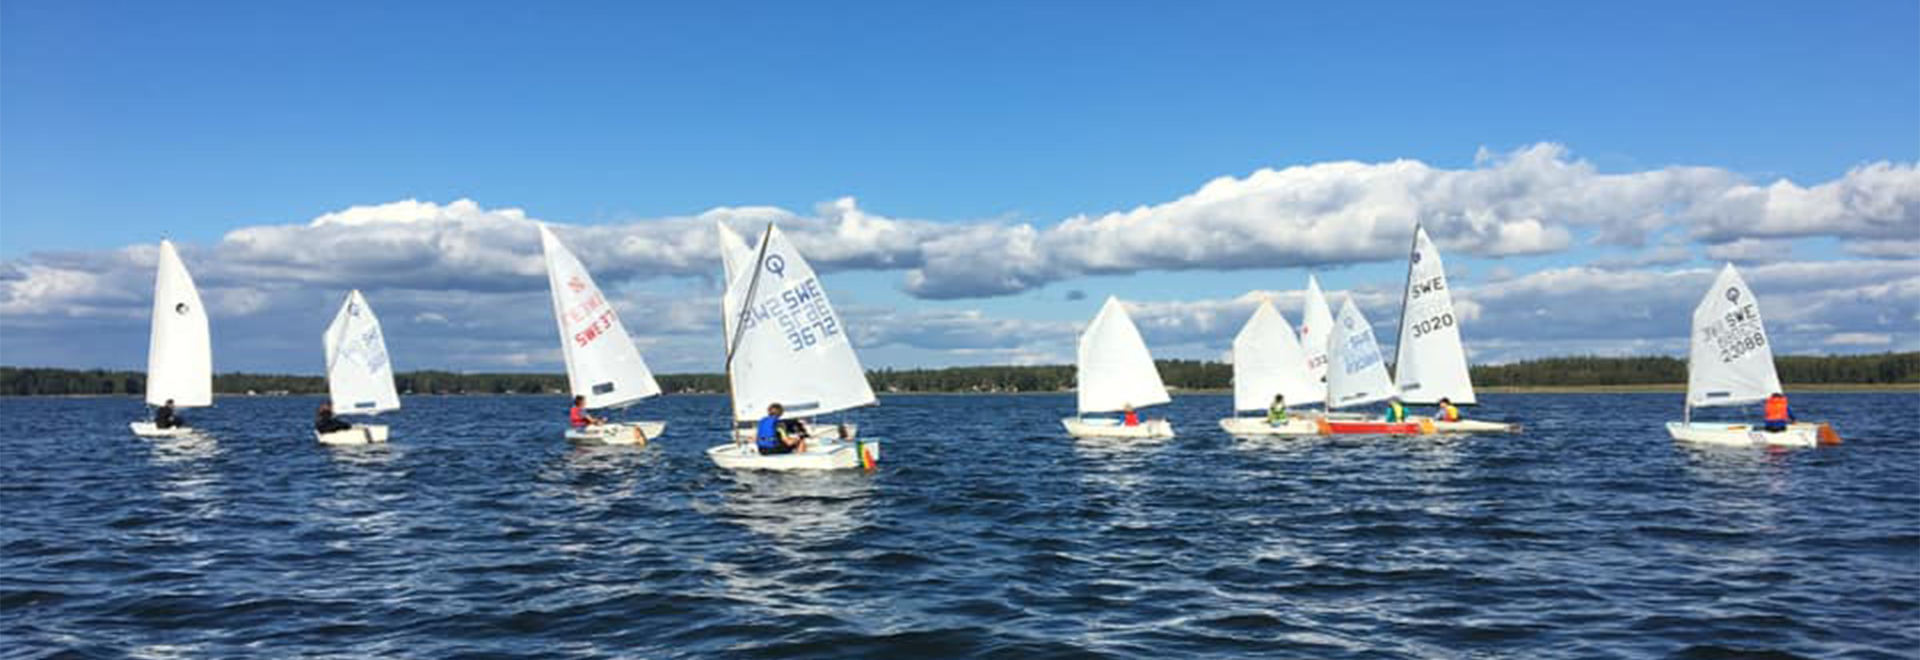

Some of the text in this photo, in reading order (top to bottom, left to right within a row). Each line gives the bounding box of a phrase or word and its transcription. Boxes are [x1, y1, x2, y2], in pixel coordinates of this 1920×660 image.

[782, 278, 820, 309] SWE
[1411, 277, 1444, 299] SWE
[1412, 313, 1453, 338] 3020
[1725, 304, 1757, 328] SWE
[787, 316, 838, 352] 3672
